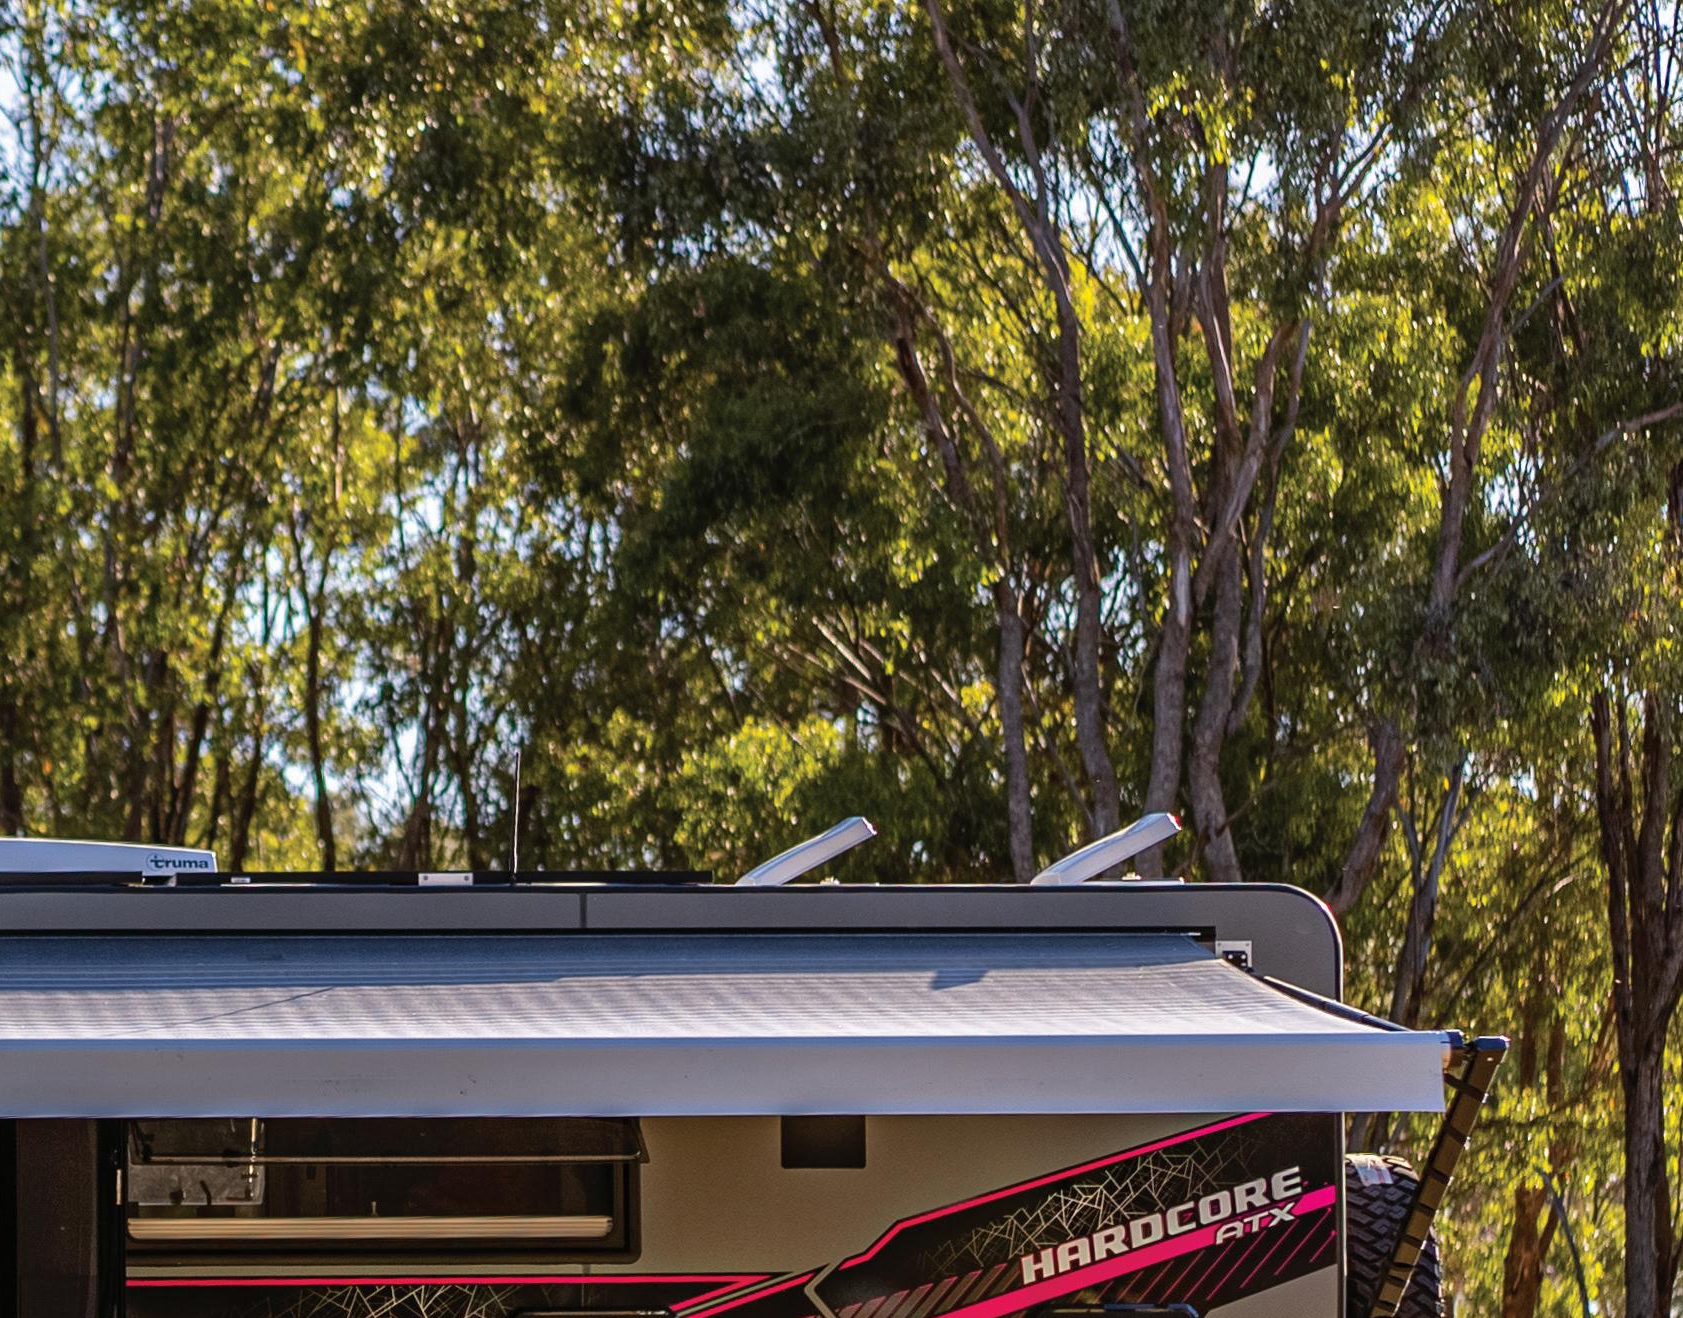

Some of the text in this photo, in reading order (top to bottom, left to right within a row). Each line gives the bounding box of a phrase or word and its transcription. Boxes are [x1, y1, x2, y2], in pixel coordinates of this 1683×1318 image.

[150, 855, 209, 869] truma
[1021, 1165, 1303, 1285] HARDCORE
[1216, 1202, 1296, 1245] ATX
